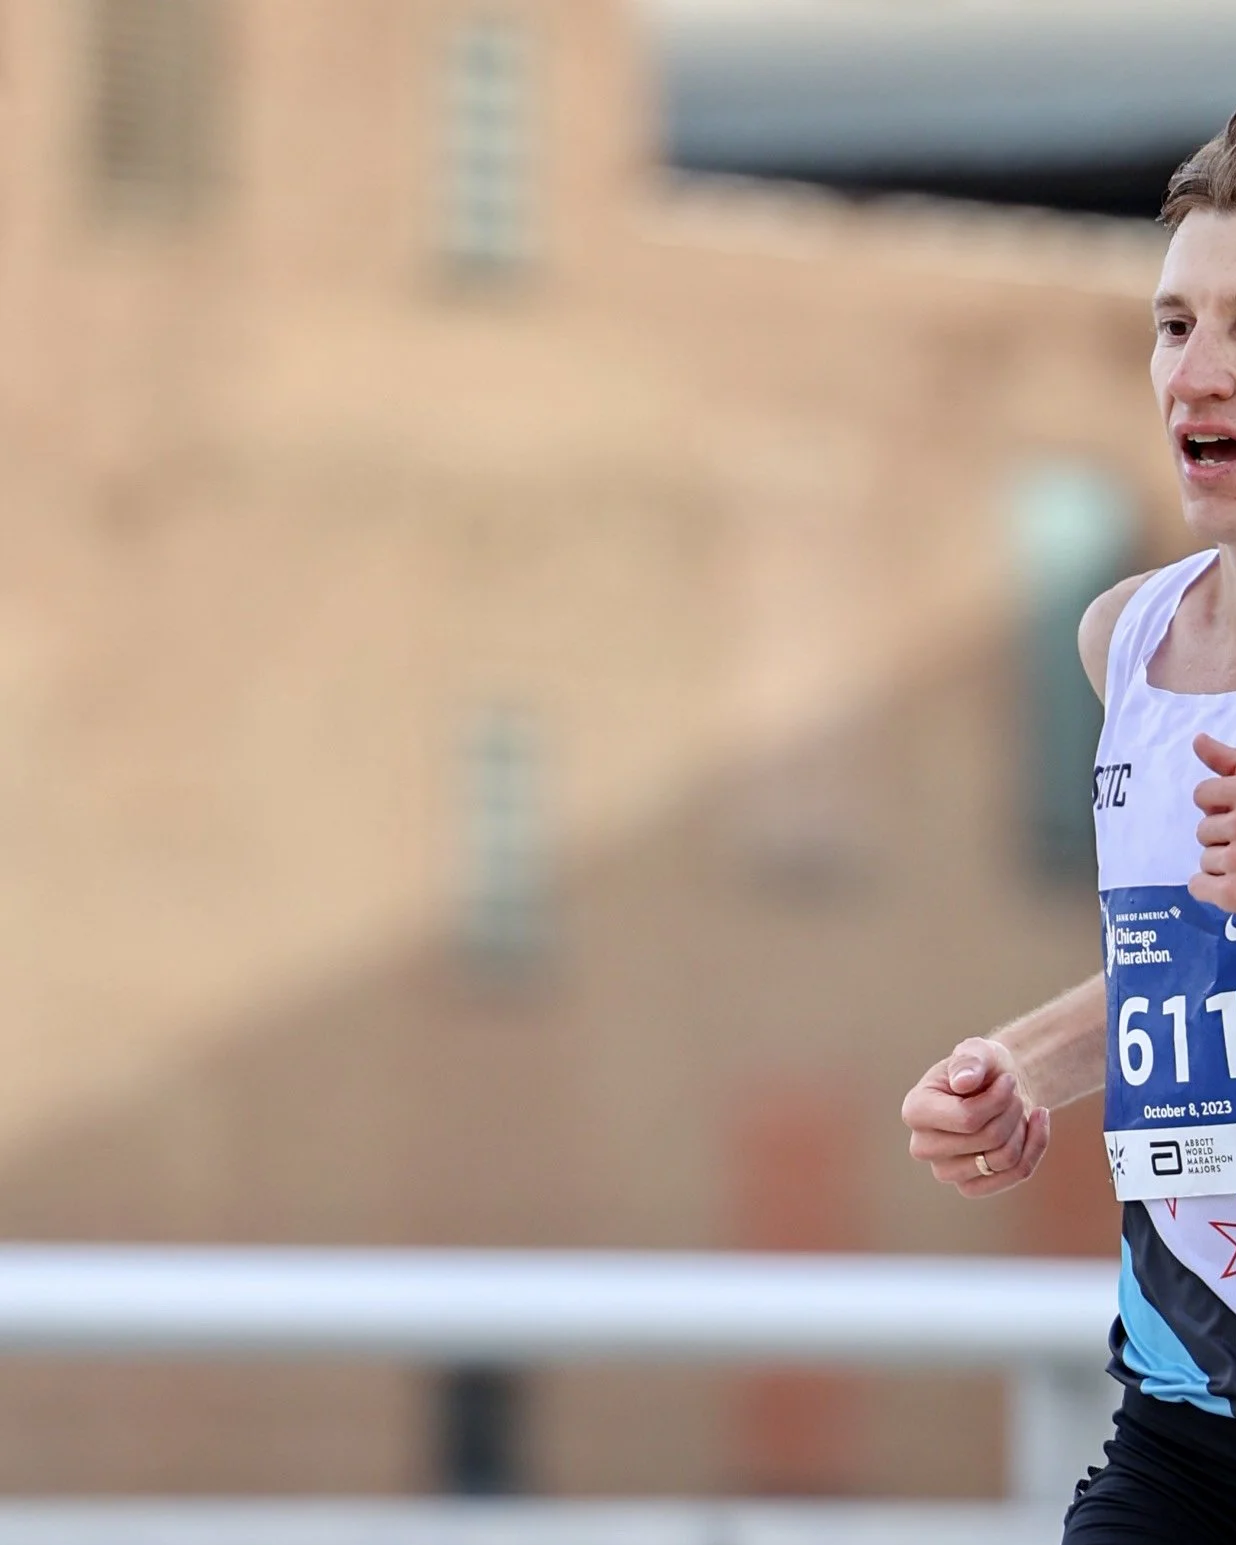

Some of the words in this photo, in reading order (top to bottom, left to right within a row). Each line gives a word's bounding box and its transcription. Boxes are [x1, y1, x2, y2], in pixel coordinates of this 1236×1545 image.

[1116, 913, 1129, 922] BANK
[1129, 913, 1138, 921] OF
[1138, 911, 1170, 920] AMERICA
[1116, 928, 1157, 947] Chicago
[1144, 1104, 1186, 1119] October
[1188, 1103, 1200, 1118] 8,
[1201, 1100, 1232, 1115] 2023
[1185, 1138, 1214, 1147] ABBOTT
[1186, 1147, 1213, 1156] WORLD
[1187, 1155, 1233, 1165] MARATHON
[1188, 1165, 1221, 1174] MAJORS
